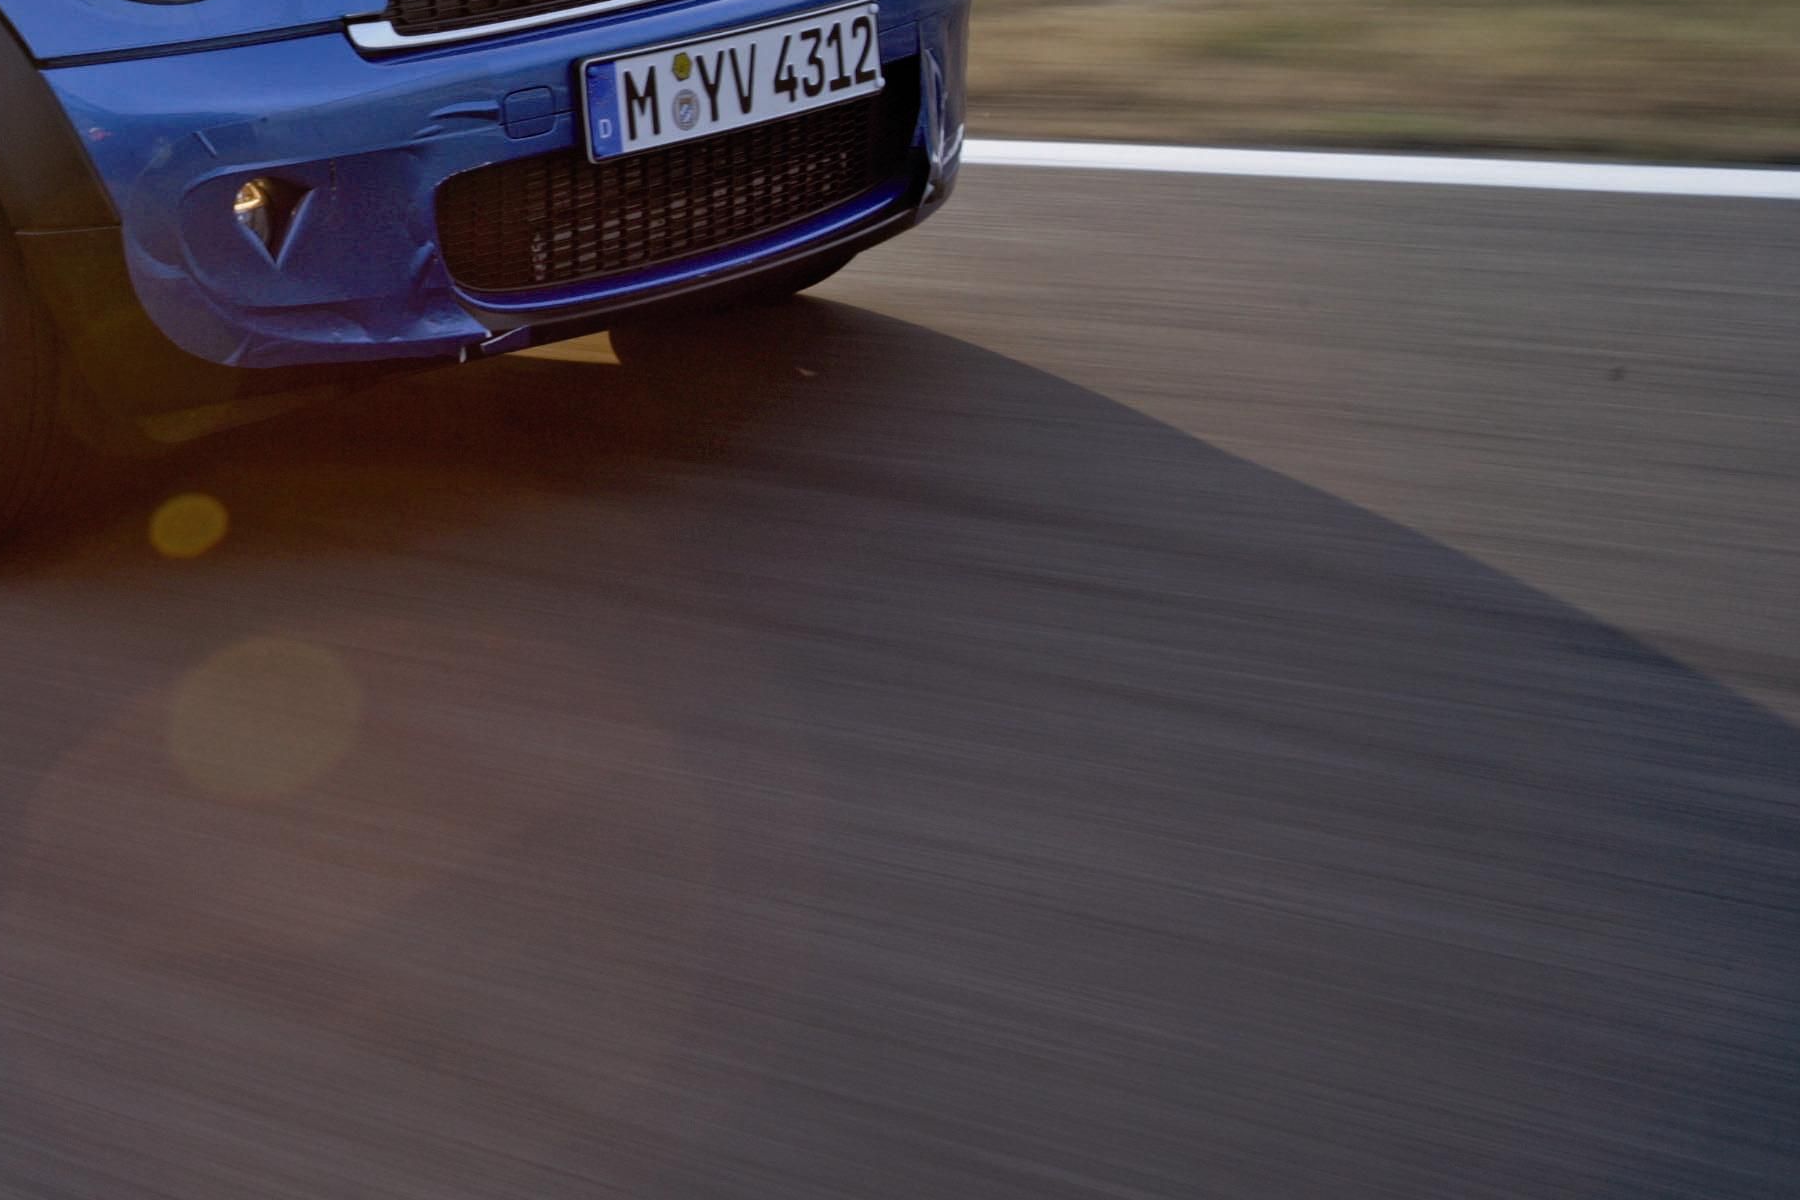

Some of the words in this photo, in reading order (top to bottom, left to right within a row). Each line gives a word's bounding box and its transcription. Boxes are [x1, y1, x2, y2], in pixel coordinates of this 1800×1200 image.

[599, 118, 612, 139] D
[623, 65, 661, 141] M
[696, 43, 756, 122] YV
[774, 15, 876, 102] 4312
